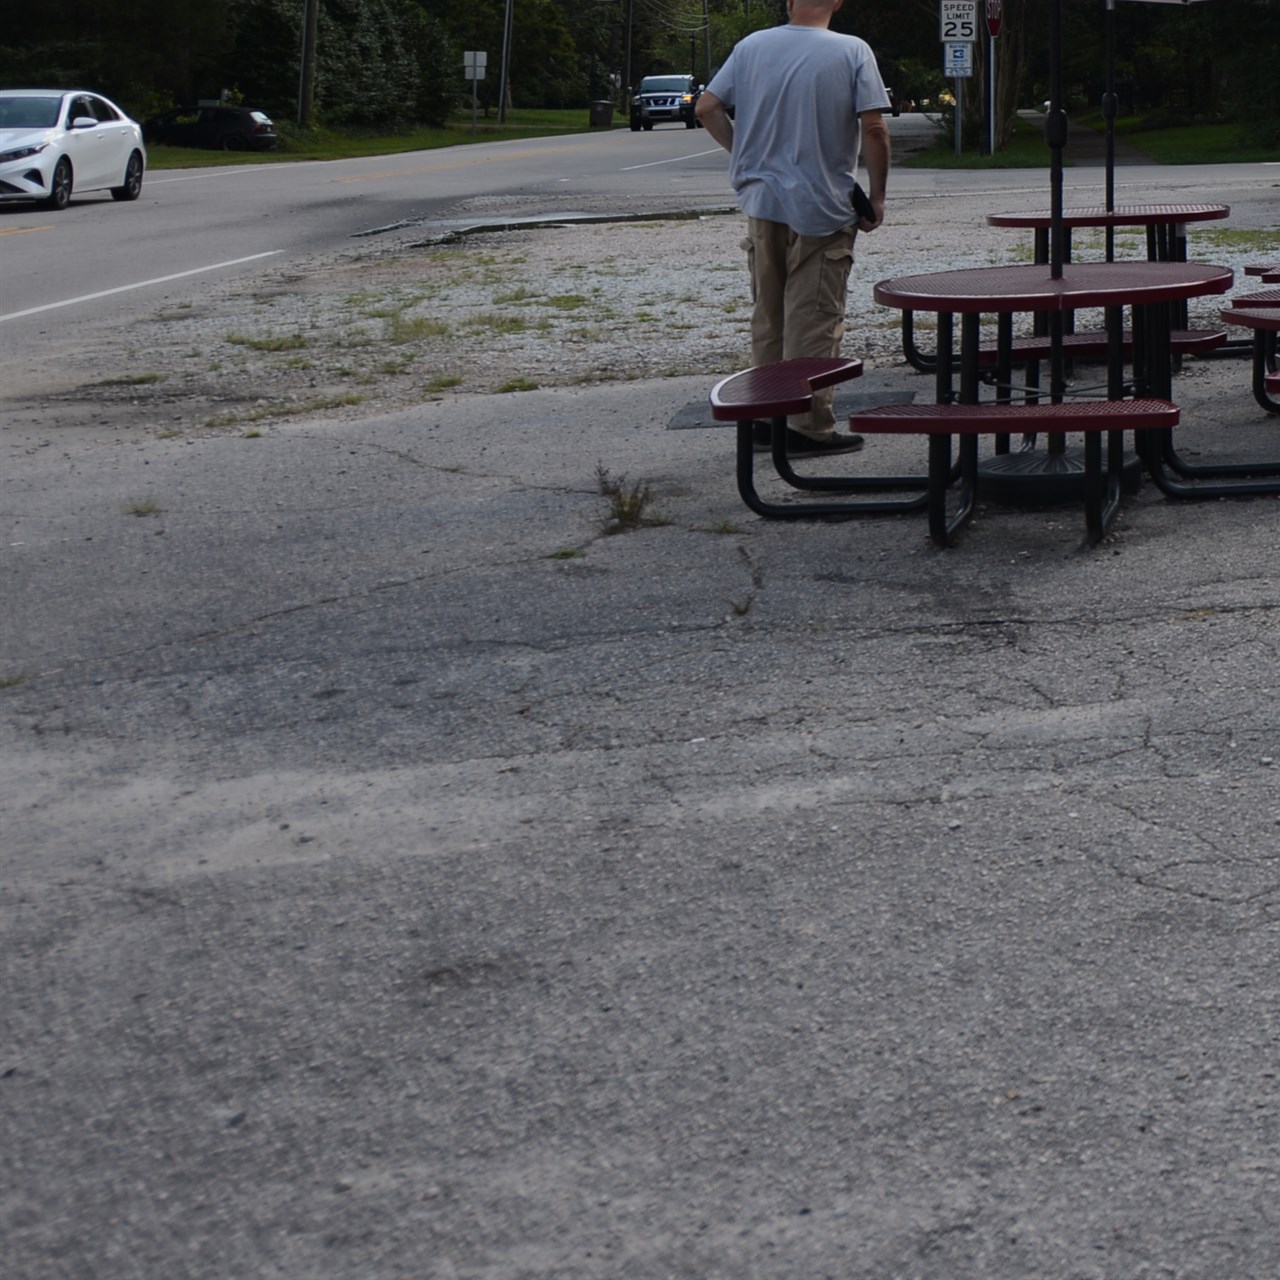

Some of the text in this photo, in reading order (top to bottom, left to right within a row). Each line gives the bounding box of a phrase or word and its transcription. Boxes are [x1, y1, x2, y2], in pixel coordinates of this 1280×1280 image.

[947, 12, 972, 20] LIMIT
[986, 0, 1002, 19] STOP
[944, 22, 974, 37] 25
